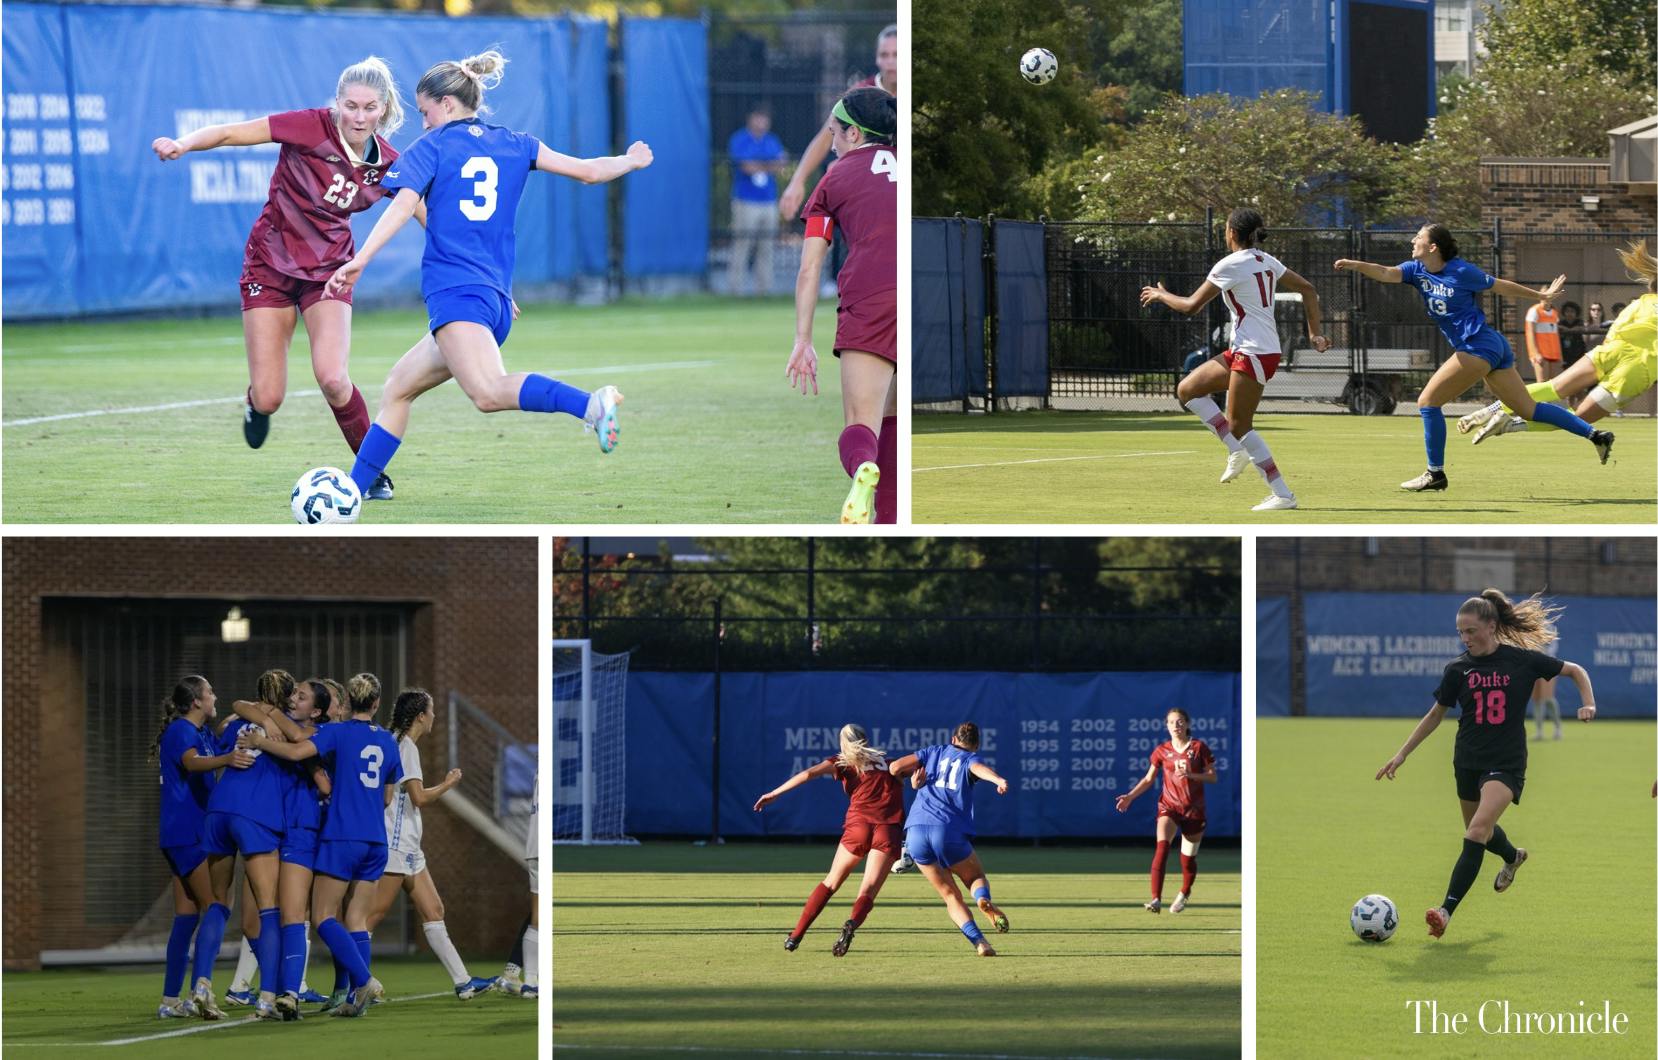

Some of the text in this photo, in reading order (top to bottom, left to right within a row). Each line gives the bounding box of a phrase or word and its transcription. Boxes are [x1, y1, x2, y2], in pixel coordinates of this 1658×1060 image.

[870, 149, 897, 182] 4
[323, 173, 359, 209] 23
[459, 156, 499, 222] 3
[1420, 278, 1455, 298] Duke
[1427, 297, 1448, 316] 13
[1466, 671, 1511, 689] Duke
[1472, 689, 1506, 726] 18
[1020, 720, 1059, 733] 1954
[1071, 719, 1116, 732] 2002
[1020, 739, 1059, 753] 1995
[1071, 738, 1117, 752] 2005
[360, 744, 384, 789] 3
[934, 757, 962, 791] 11
[1020, 758, 1059, 772] 1999
[1071, 758, 1115, 771] 2007
[1174, 759, 1187, 772] 15
[1020, 777, 1060, 791] 2001
[1071, 777, 1117, 791] 2008
